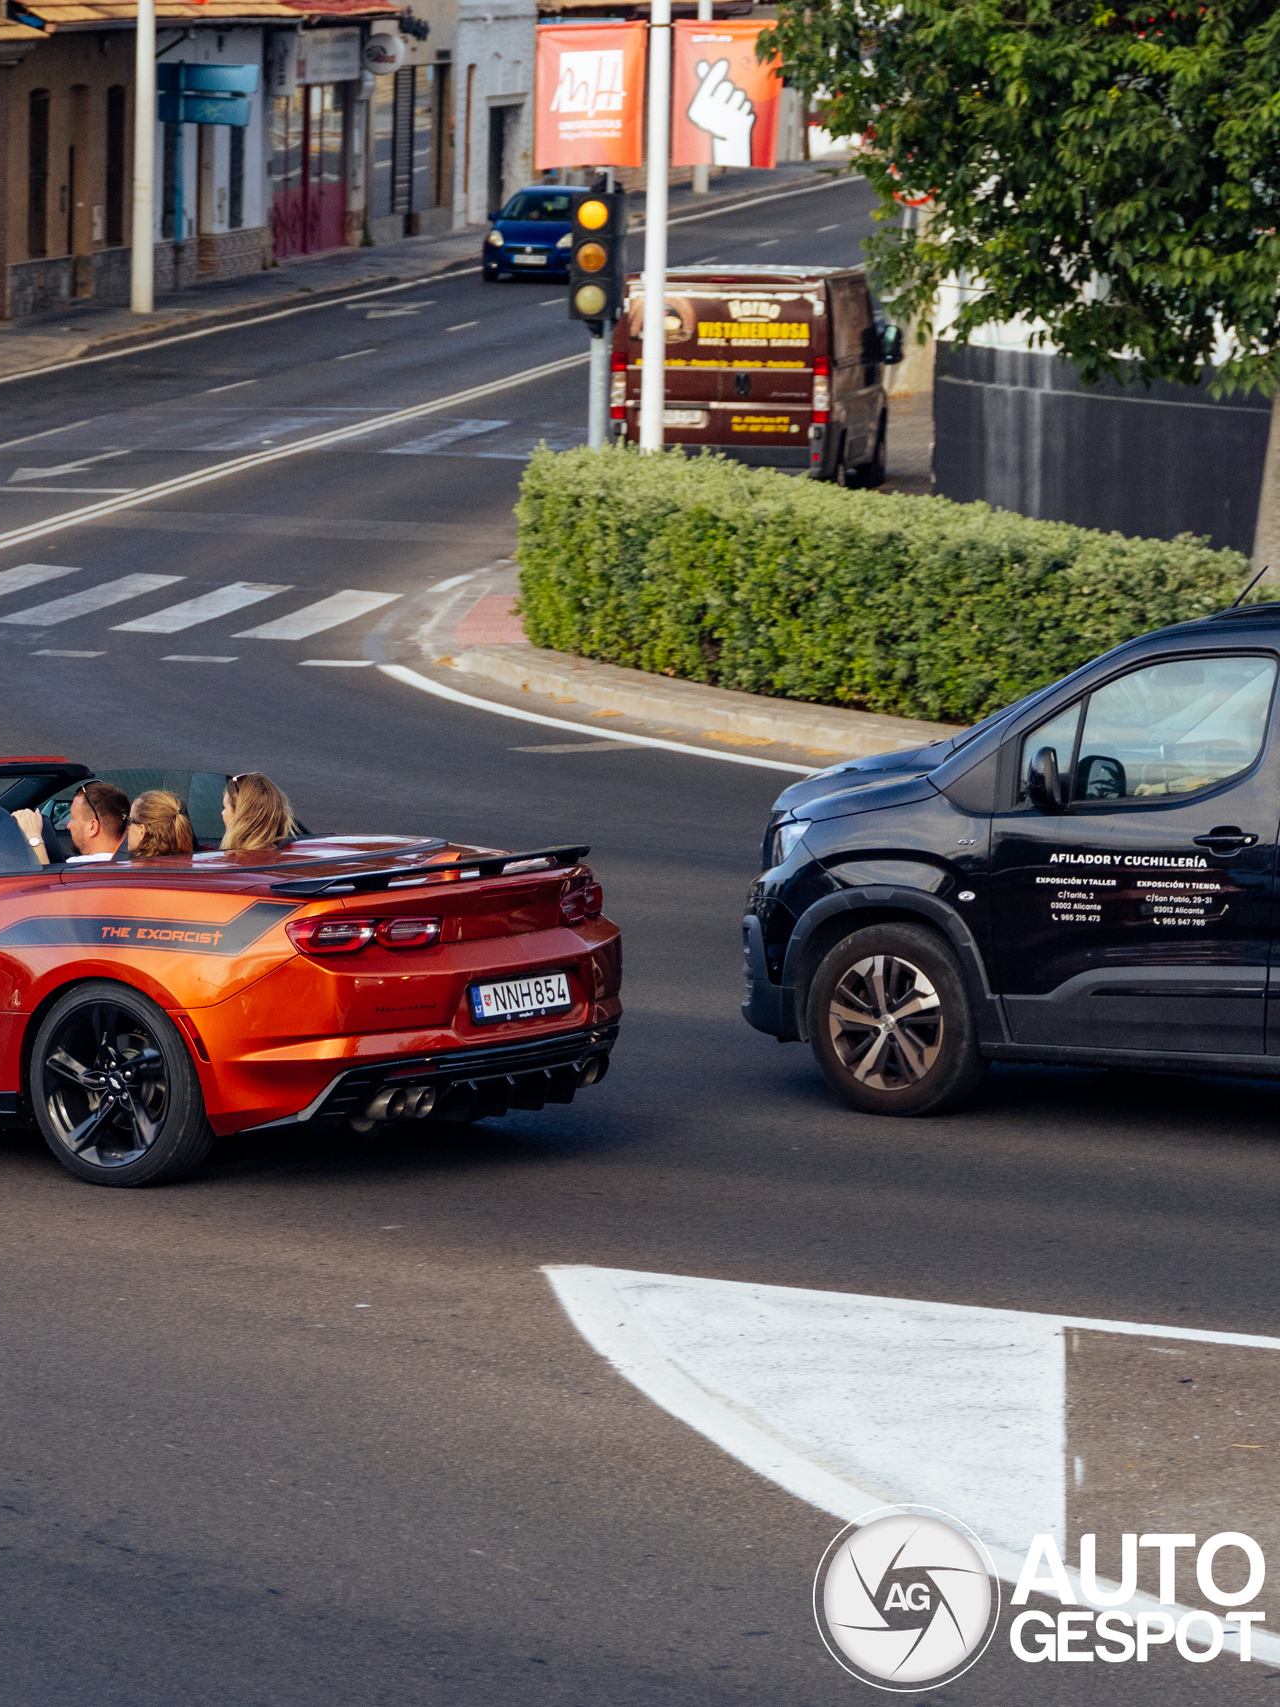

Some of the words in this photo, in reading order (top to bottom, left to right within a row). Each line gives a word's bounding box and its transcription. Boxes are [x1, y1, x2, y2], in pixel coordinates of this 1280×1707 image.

[558, 119, 623, 131] UNIVERSITAS
[727, 300, 781, 319] Horno
[697, 322, 810, 339] VISTAHERMOSA
[1049, 853, 1111, 865] AFILADOR
[1113, 855, 1122, 865] Y
[1124, 855, 1208, 868] CUCHILLERÍA
[1035, 876, 1081, 885] EXPOSICIÓN
[1089, 879, 1117, 887] TALLER
[1136, 880, 1184, 889] EXPOSICIÓN
[1191, 882, 1221, 890] TIENDA
[1057, 890, 1089, 900] C/Tarifa,
[1145, 894, 1168, 903] C/San
[1169, 895, 1192, 904] Pablo,
[1050, 901, 1072, 910] 03002
[1073, 902, 1102, 911] Alicante
[1153, 905, 1174, 914] 03012
[1174, 906, 1205, 915] Alicante
[1075, 914, 1087, 922] 215
[1087, 914, 1101, 923] 473
[101, 926, 132, 939] THE
[136, 928, 224, 946] EXORCIST
[492, 976, 567, 1012] NNH854
[475, 1004, 483, 1013] LT
